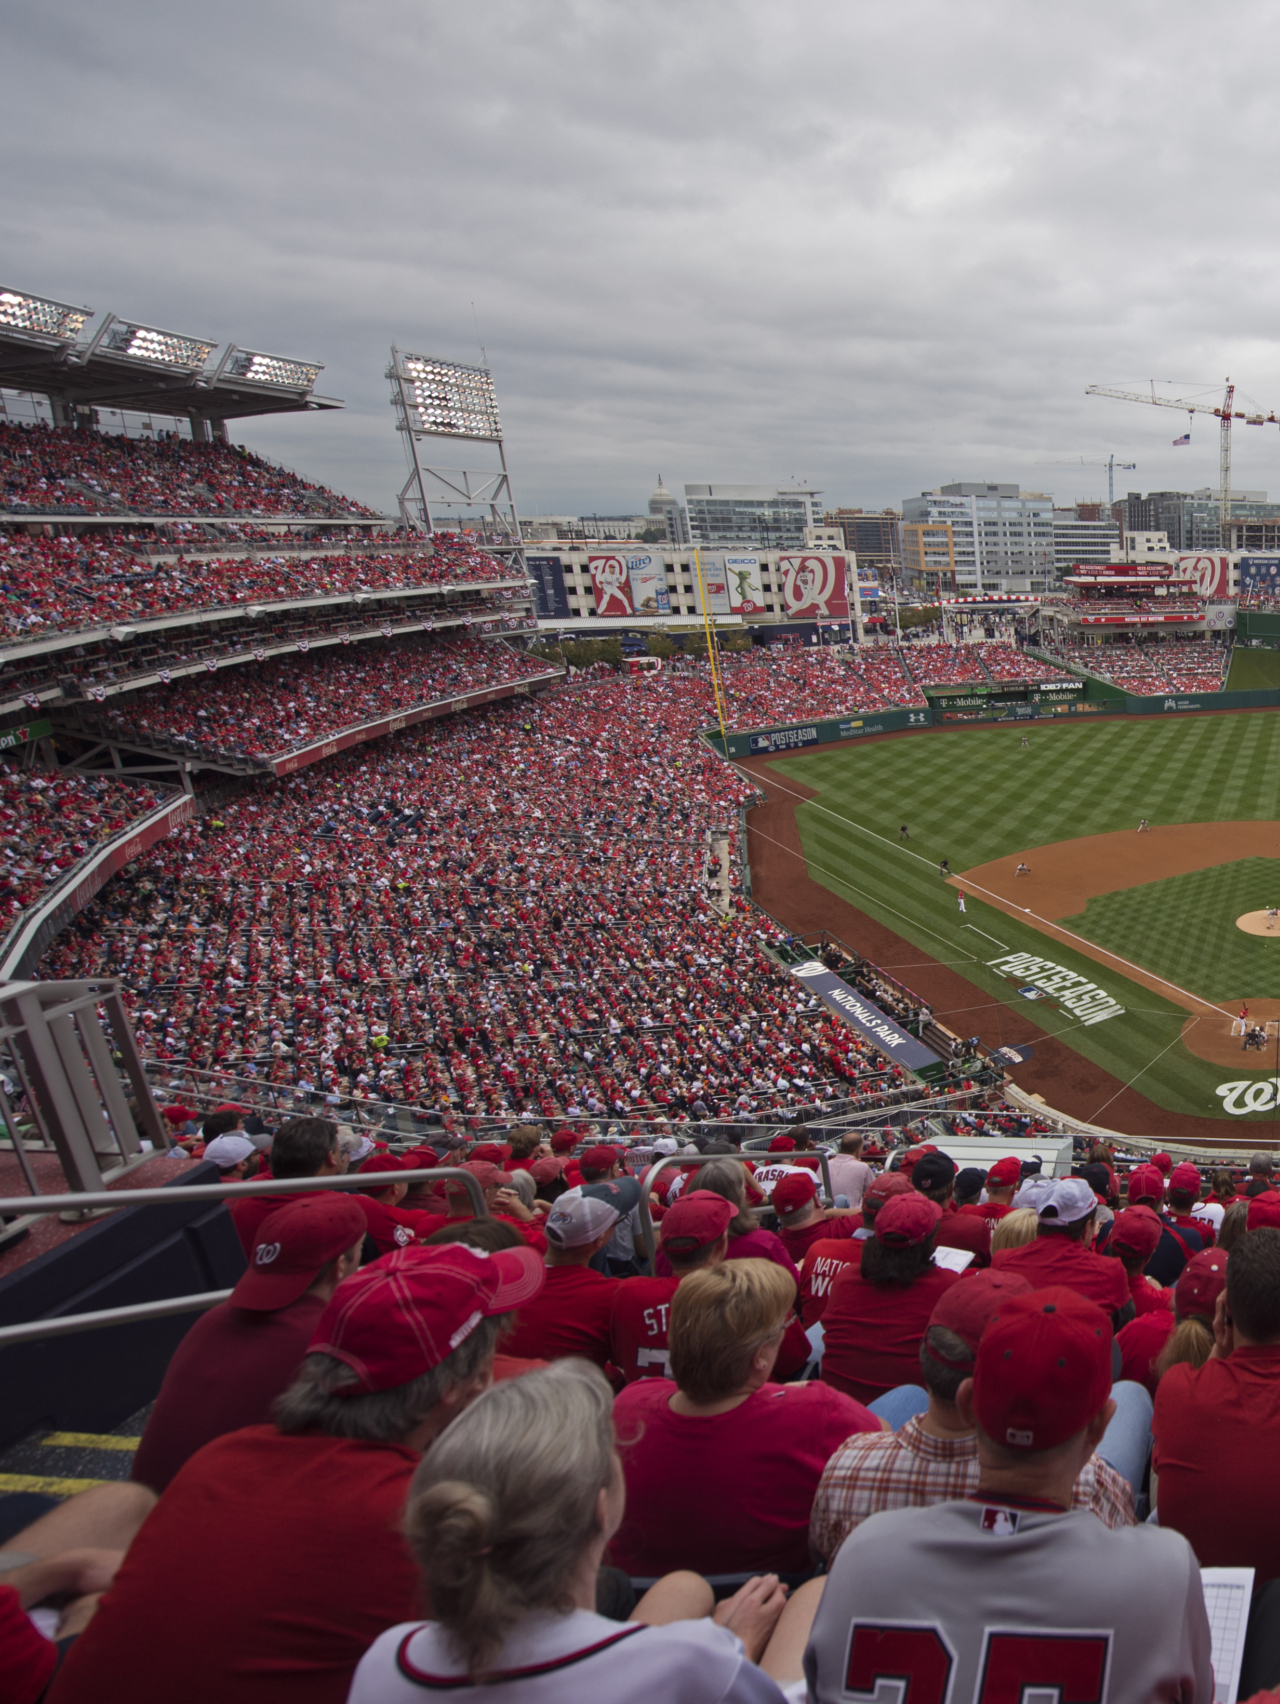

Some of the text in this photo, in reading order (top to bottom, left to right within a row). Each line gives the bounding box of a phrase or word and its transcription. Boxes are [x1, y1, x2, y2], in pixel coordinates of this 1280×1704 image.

[1062, 682, 1082, 690] FAN
[770, 727, 818, 746] POSTSEASON
[840, 724, 883, 737] MedStar Health
[986, 952, 1126, 1026] POSTSEASON
[828, 988, 907, 1048] NATIONALS PARK
